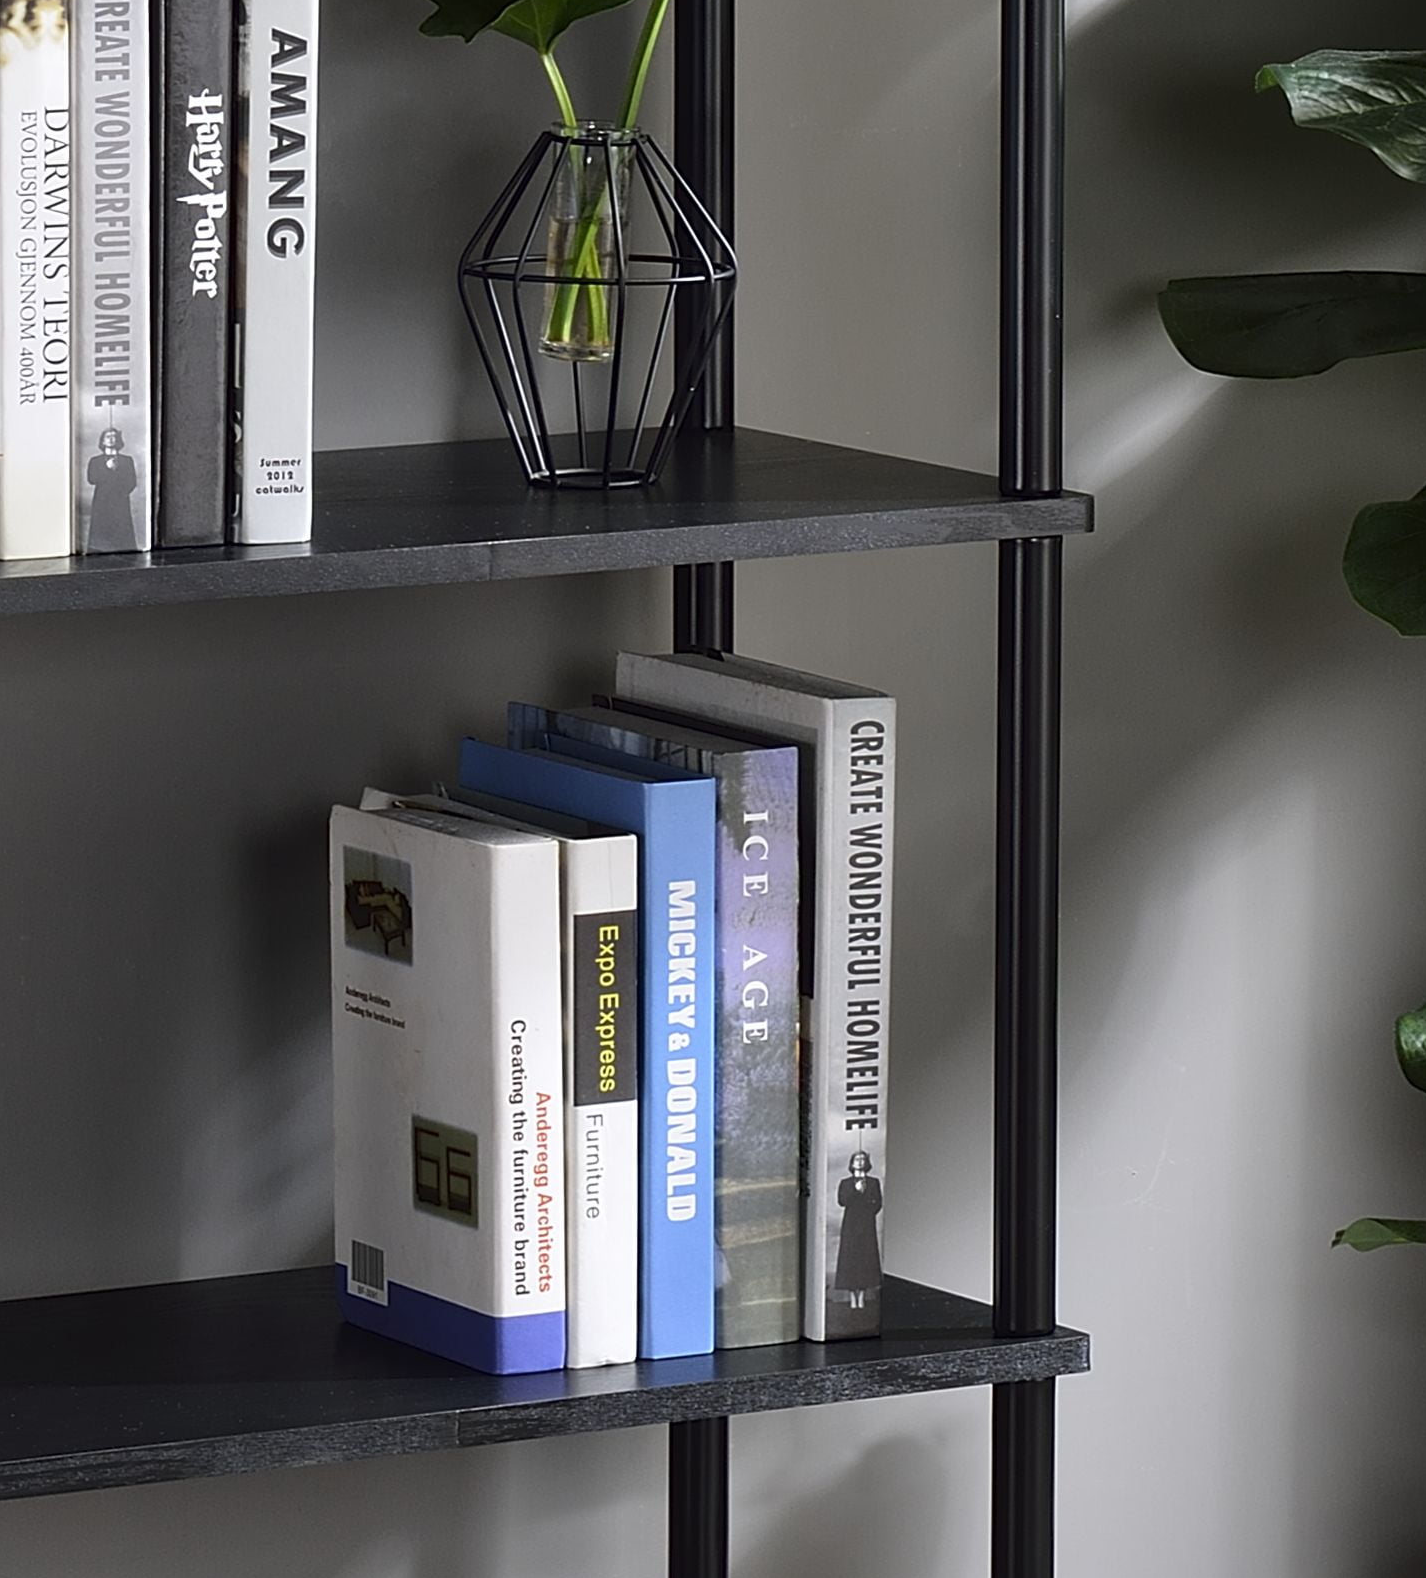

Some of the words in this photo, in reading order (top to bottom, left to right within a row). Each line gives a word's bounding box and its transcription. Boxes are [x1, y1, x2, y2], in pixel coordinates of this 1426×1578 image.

[16, 111, 37, 230] EVOLUSJON
[94, 91, 132, 262] WONDERFUL
[186, 88, 225, 190] Harry
[266, 28, 307, 259] AMANG
[44, 107, 69, 279] DARWINS
[15, 238, 37, 341] GJENNOM
[176, 190, 227, 298] Potter
[94, 272, 131, 407] HOMELIFE
[255, 485, 304, 494] catwalks
[260, 458, 301, 467] Summer
[266, 471, 294, 480] 2012
[849, 720, 884, 814] CREATE
[743, 810, 769, 897] ICE
[668, 880, 695, 1029] MICKEY
[847, 823, 883, 989] WONDERFUL
[595, 926, 619, 987] Expo
[743, 945, 769, 1044] AGE
[508, 1020, 527, 1105] Creating
[595, 993, 619, 1092] Express
[668, 1032, 690, 1052] &
[845, 1000, 880, 1130] HOMELIFE
[513, 1110, 528, 1142] the
[533, 1092, 552, 1187] Anderegg
[585, 1114, 603, 1219] Furniture
[667, 1059, 696, 1222] DONALD
[513, 1149, 529, 1232] furniture
[514, 1239, 530, 1296] brand
[537, 1193, 554, 1293] Architects
